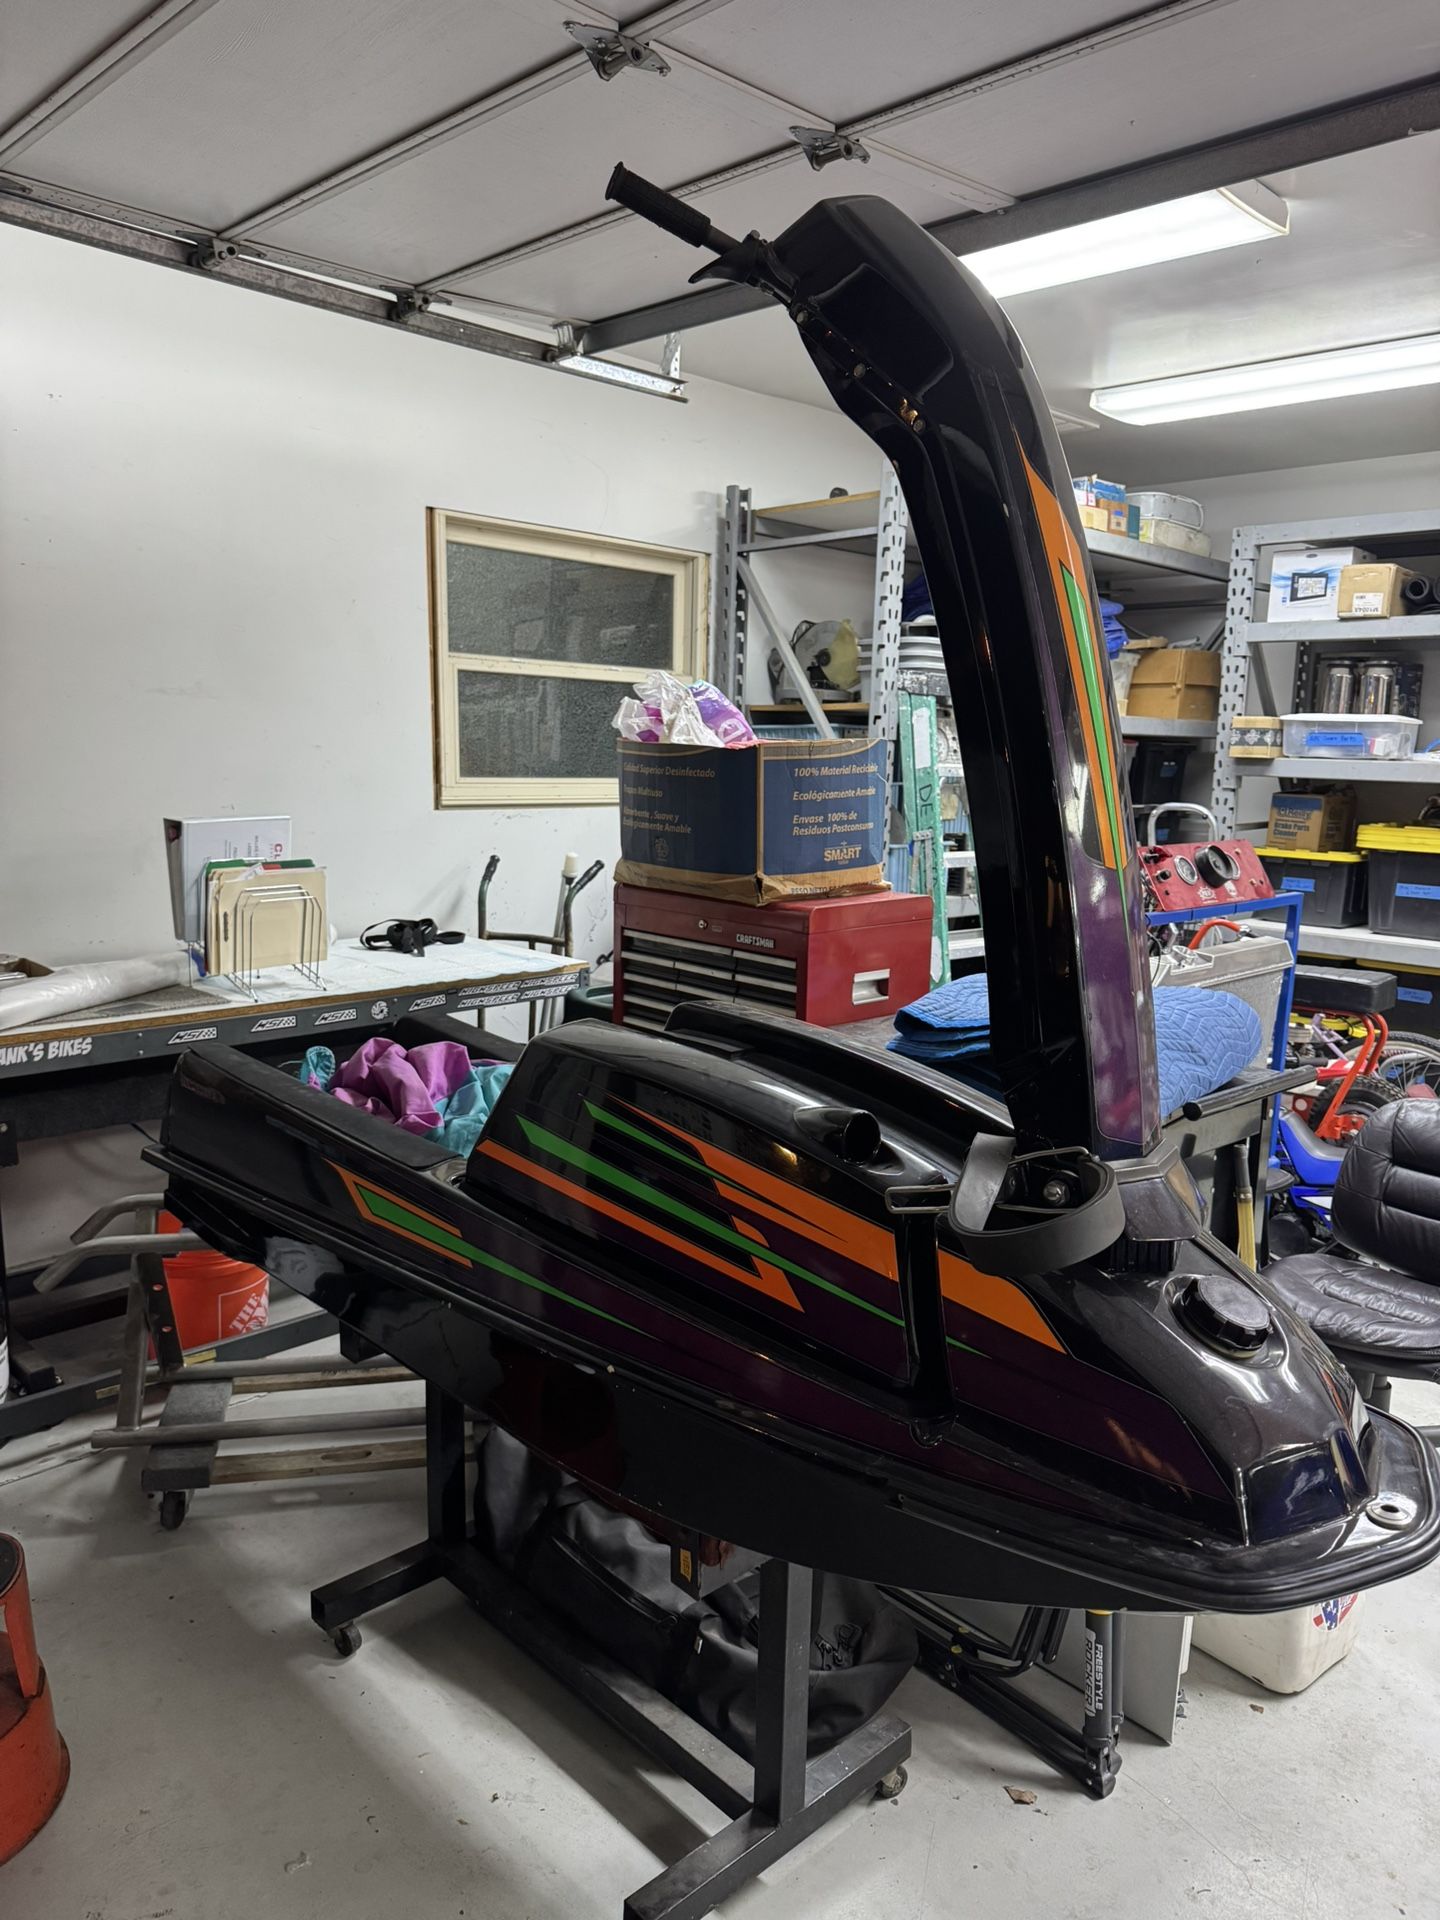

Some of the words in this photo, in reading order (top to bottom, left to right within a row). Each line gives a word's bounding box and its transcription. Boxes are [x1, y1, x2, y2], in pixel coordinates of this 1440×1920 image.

[665, 767, 715, 778] Desinfectado
[794, 767, 819, 777] 100%
[820, 765, 851, 776] Material
[793, 789, 855, 802] Ecológicamente
[793, 815, 824, 824] Envase
[828, 812, 847, 822] 100%
[793, 826, 831, 836] Residuos
[824, 847, 861, 861] SMART
[736, 933, 774, 949] CRAFTSMAN
[48, 1037, 92, 1059] BIKES
[229, 1293, 260, 1331] THE
[1085, 1638, 1093, 1706] ROCKER
[1095, 1643, 1103, 1710] FREESTYLE
